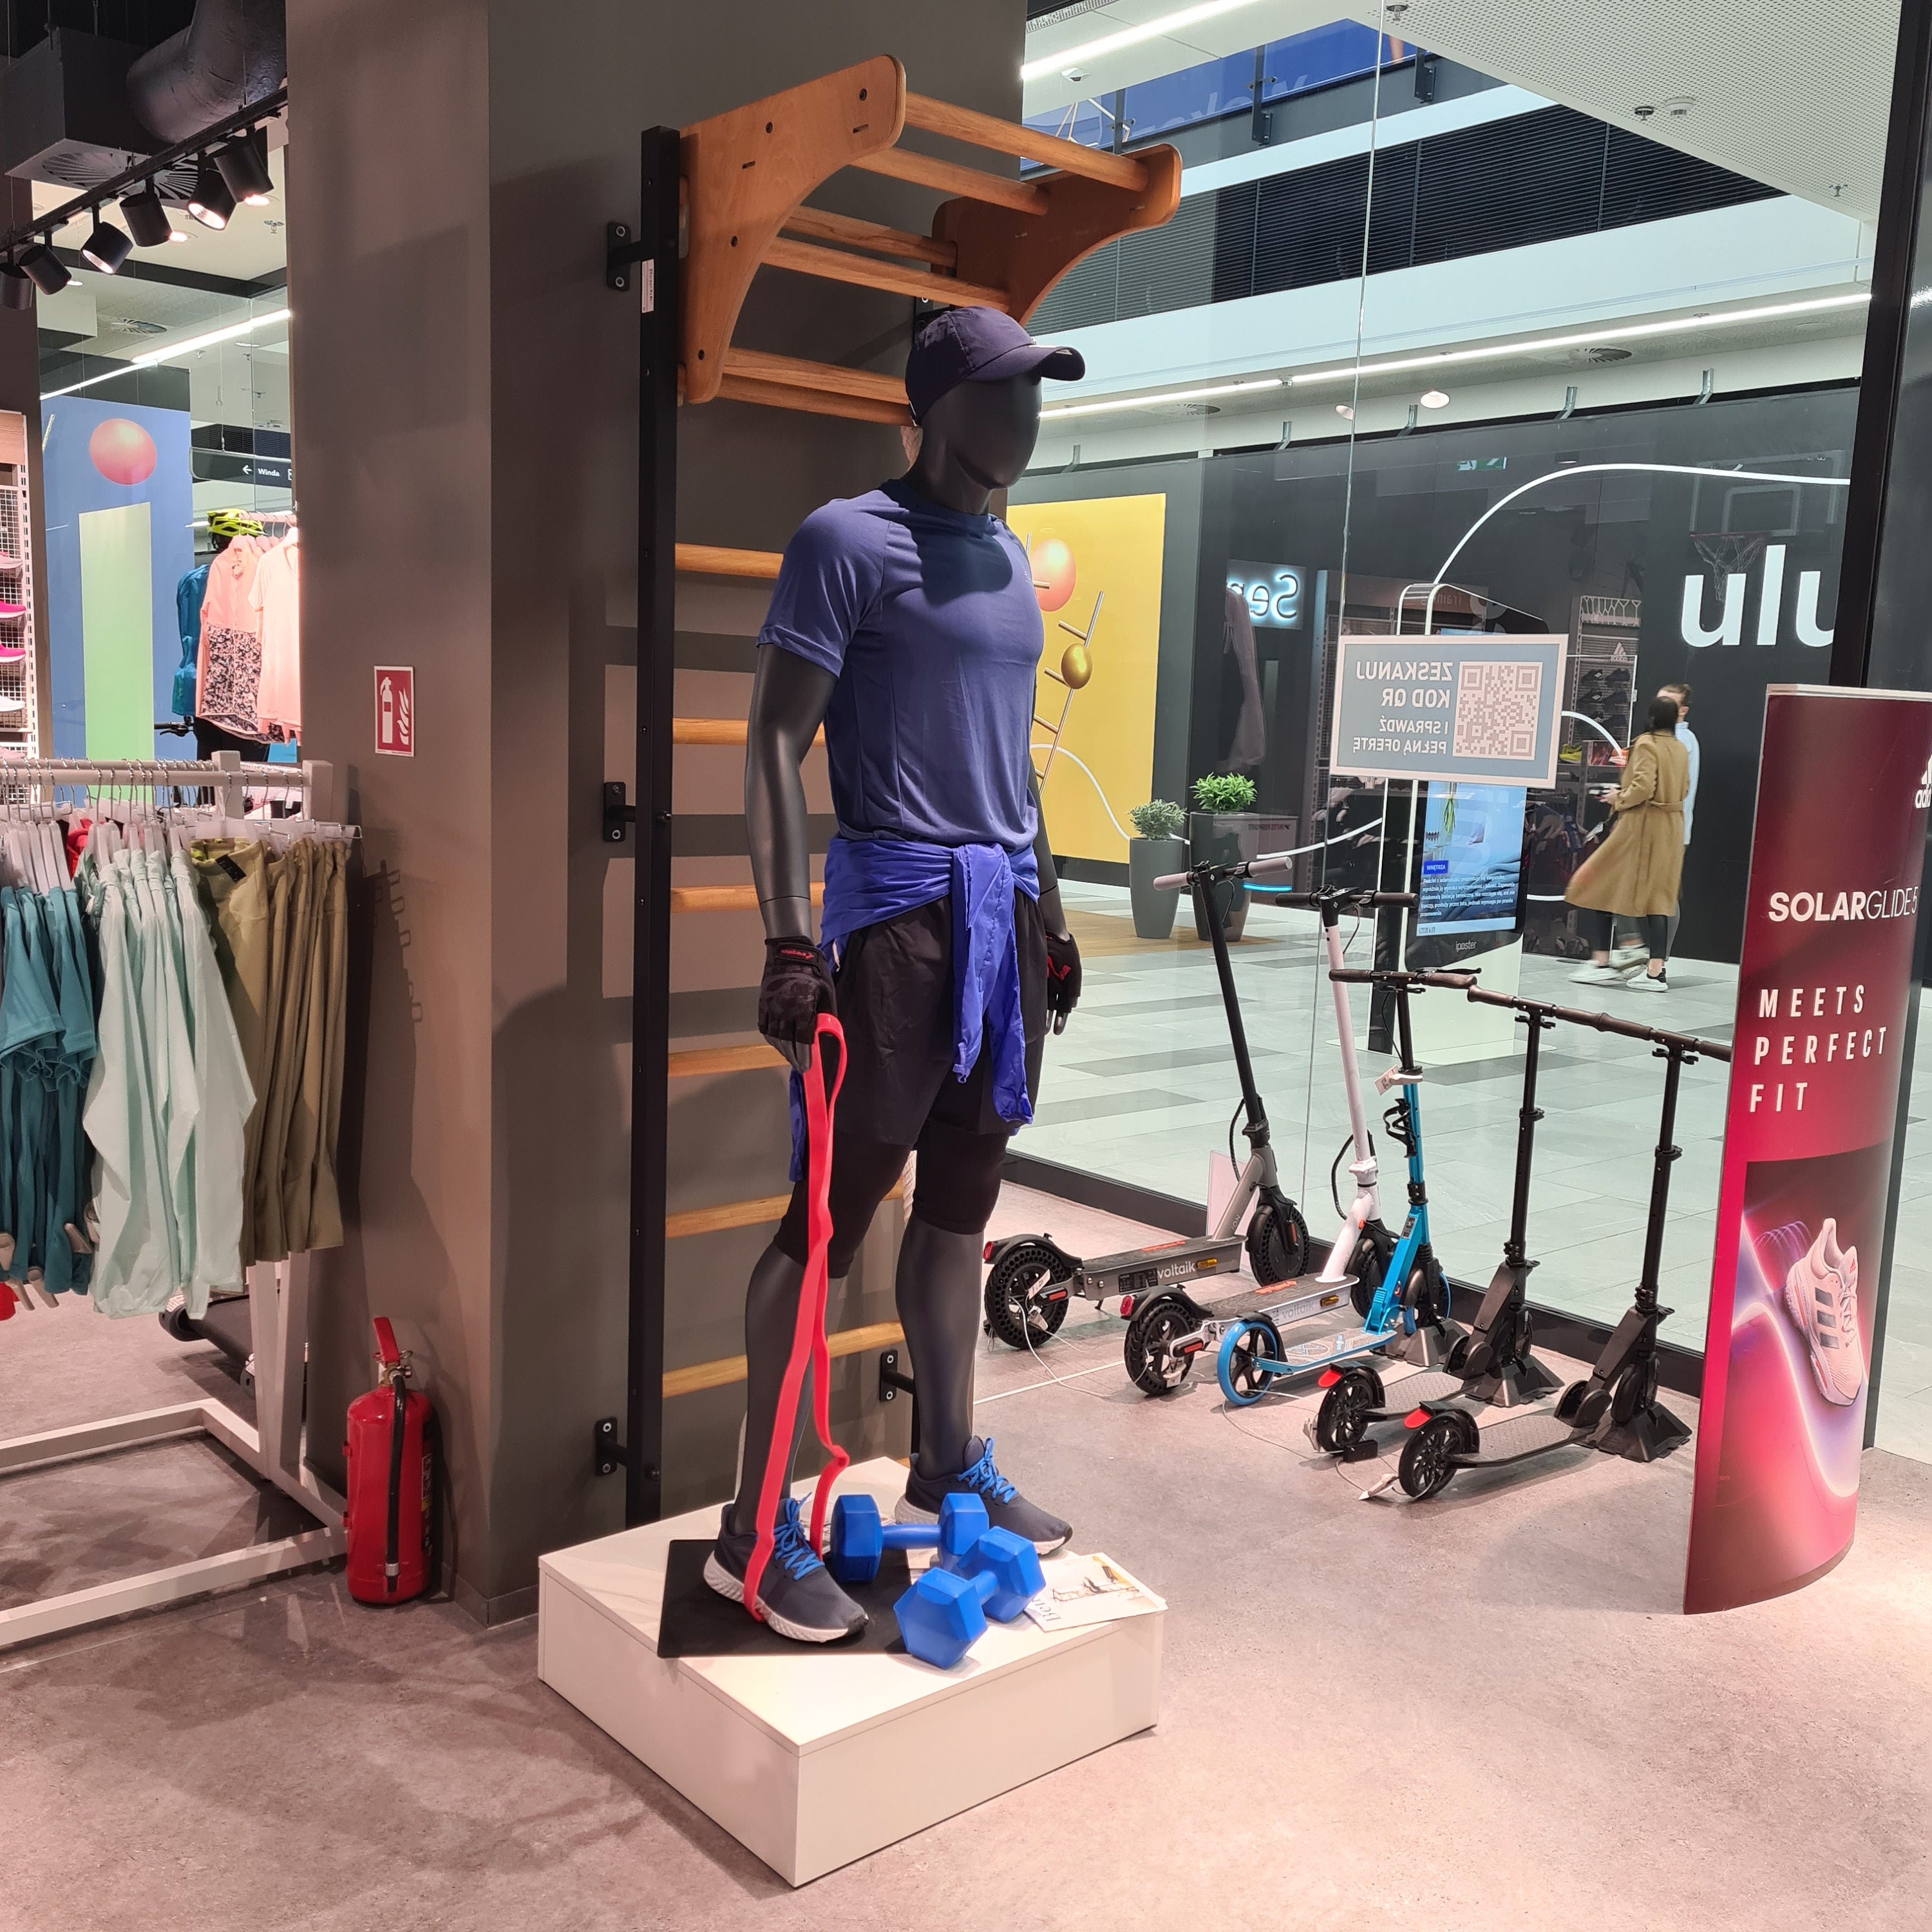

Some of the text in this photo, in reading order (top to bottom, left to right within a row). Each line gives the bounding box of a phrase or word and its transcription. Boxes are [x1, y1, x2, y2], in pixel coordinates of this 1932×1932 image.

[258, 468, 280, 477] Winda
[1759, 984, 1866, 1018] MEETS
[1754, 1026, 1888, 1066] PERFECT
[1749, 1081, 1809, 1113] FIT
[1157, 1260, 1196, 1280] voltaik
[1282, 1301, 1314, 1320] voltaik
